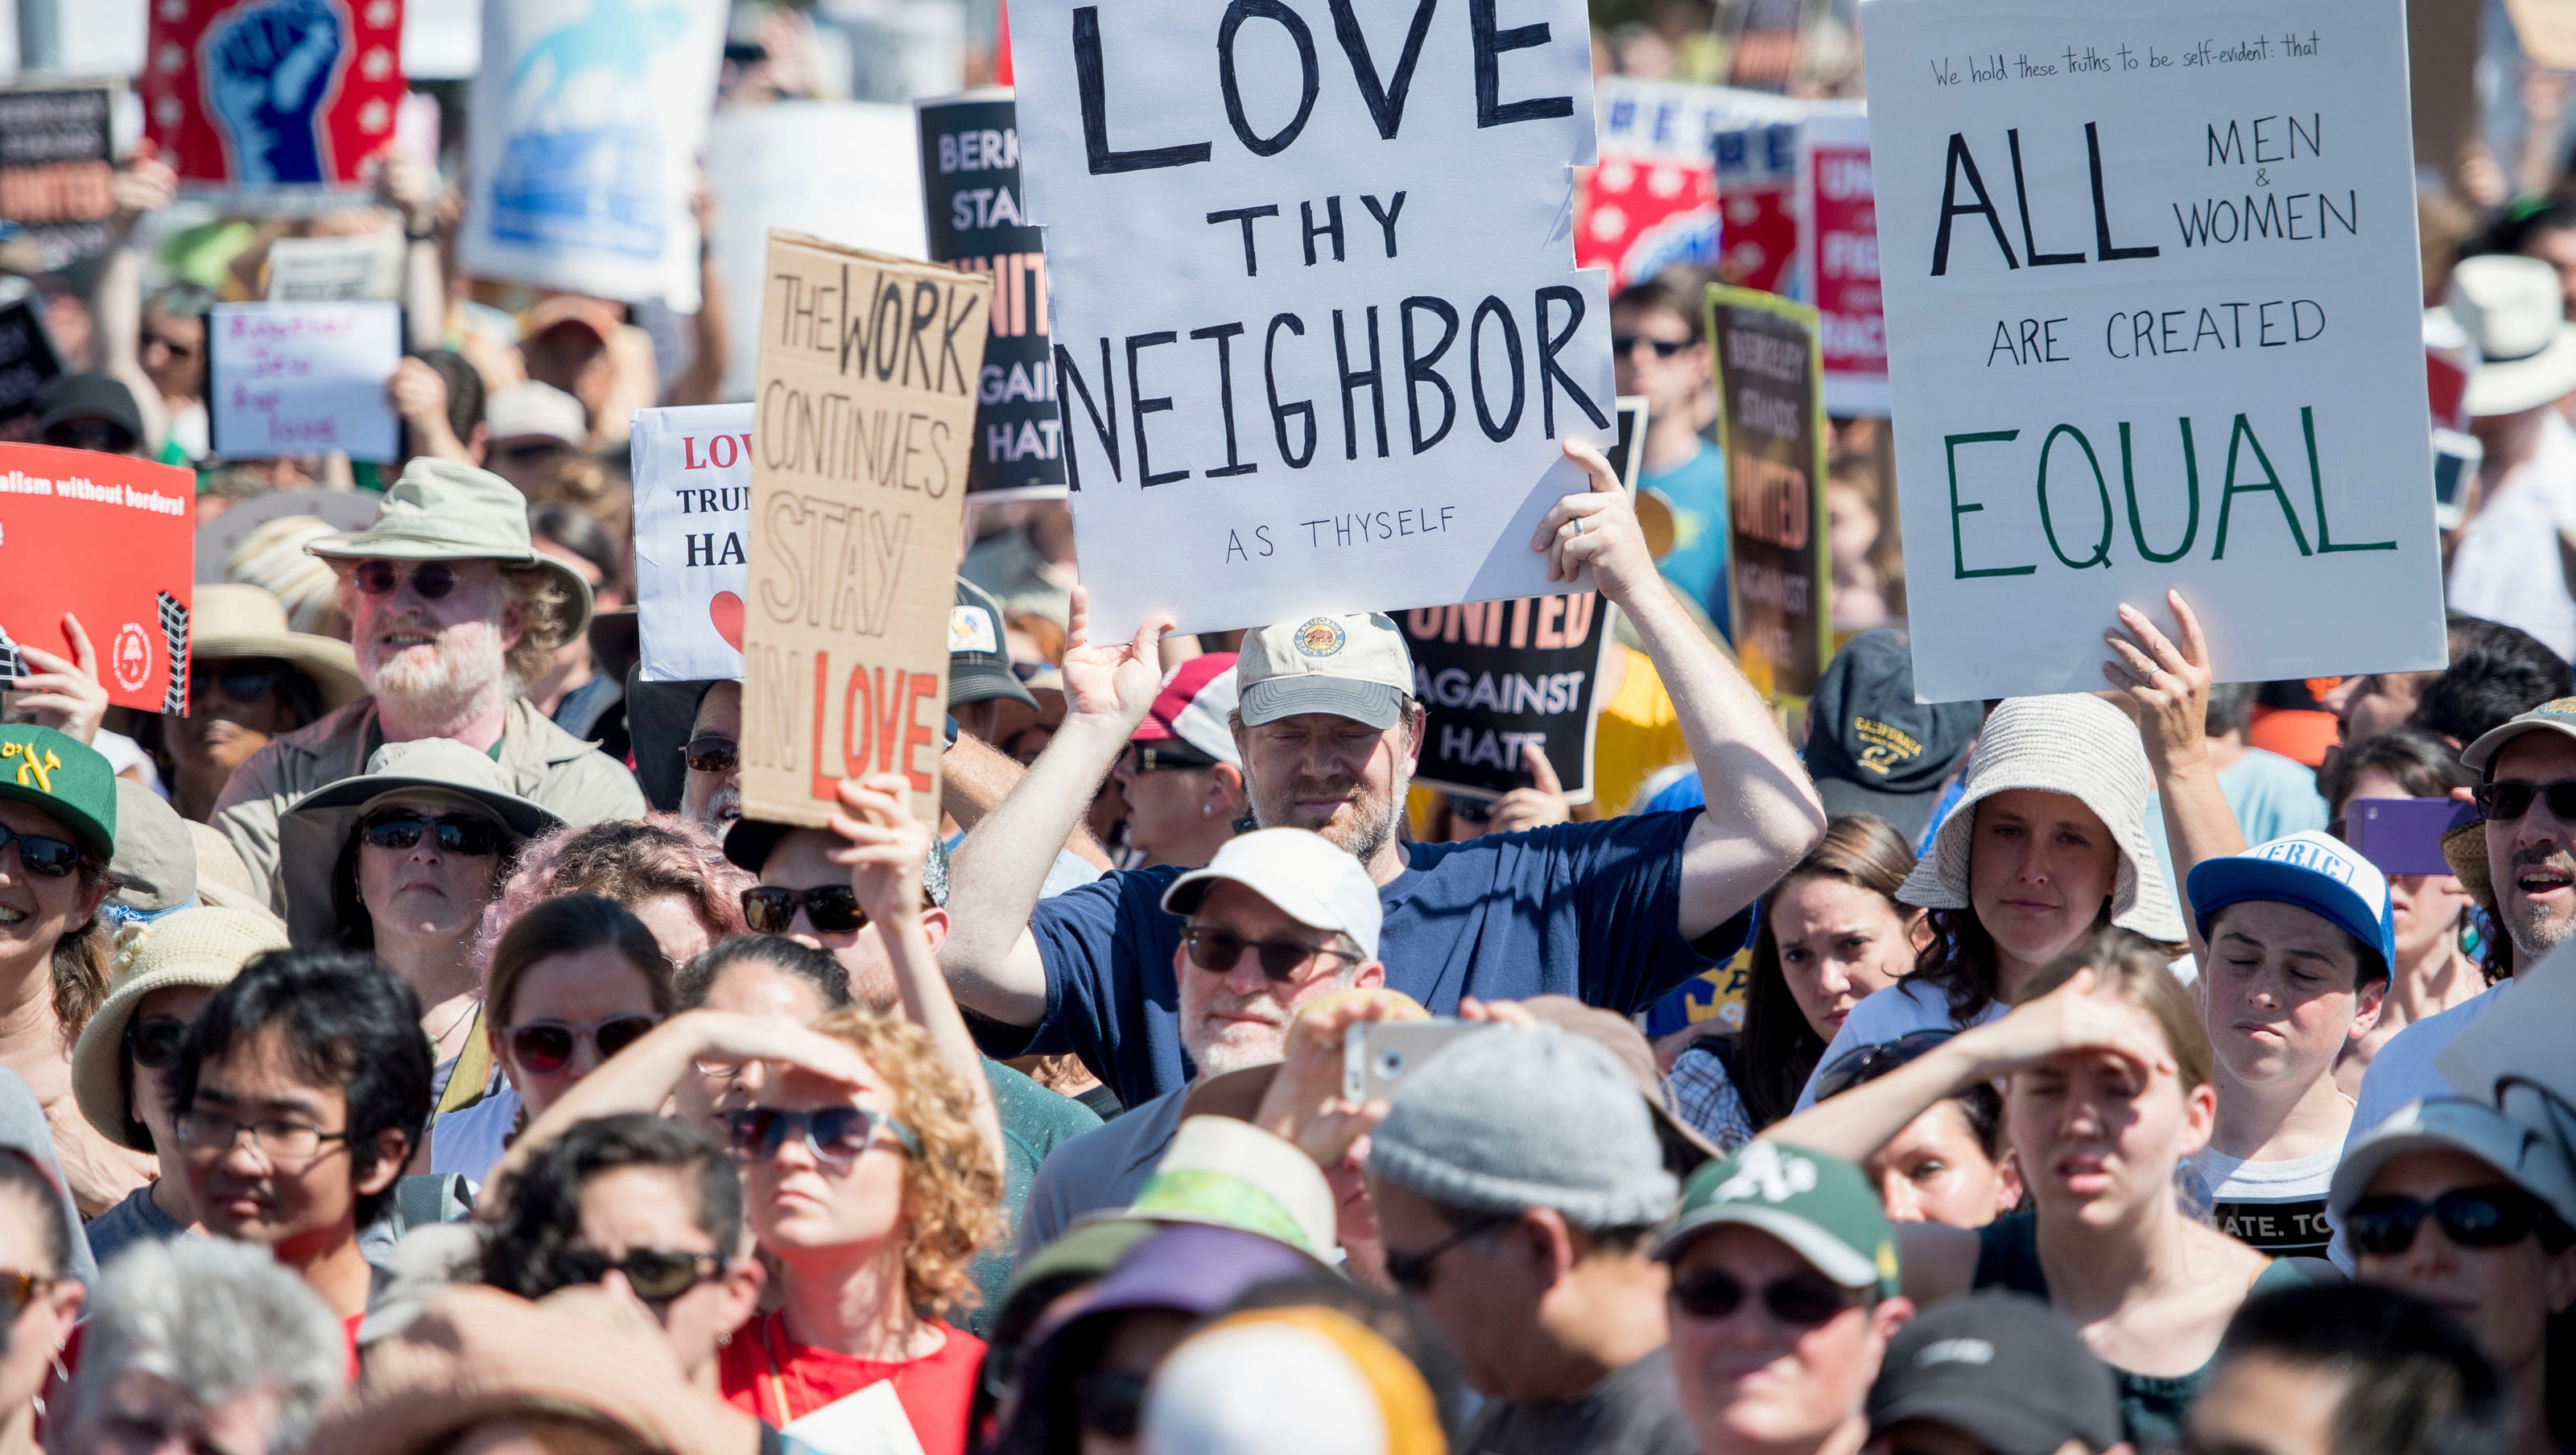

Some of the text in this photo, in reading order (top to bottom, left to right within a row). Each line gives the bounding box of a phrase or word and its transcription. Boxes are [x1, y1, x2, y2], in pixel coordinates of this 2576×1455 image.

[1072, 0, 1574, 175] LOVE
[1930, 29, 2321, 86] We hold these truths to be self-evident: that
[2207, 113, 2321, 167] MEN
[2255, 167, 2271, 188] &
[1207, 191, 1407, 277] THY
[1930, 122, 2160, 277] ALL
[2173, 190, 2357, 249] WOMEN
[774, 263, 979, 396] THE WORK
[1987, 299, 2326, 368] ARE CREATED
[1054, 285, 1610, 493] NEIGHBOR
[762, 378, 951, 500] CONTINUES
[56, 476, 123, 505] without
[1943, 405, 2399, 580] EQUAL
[760, 490, 911, 637] STAY
[1226, 505, 1456, 564] AS THYSELF
[811, 650, 938, 802] LOVE
[1414, 663, 1585, 715] AGAINST
[2266, 844, 2340, 877] ERIC
